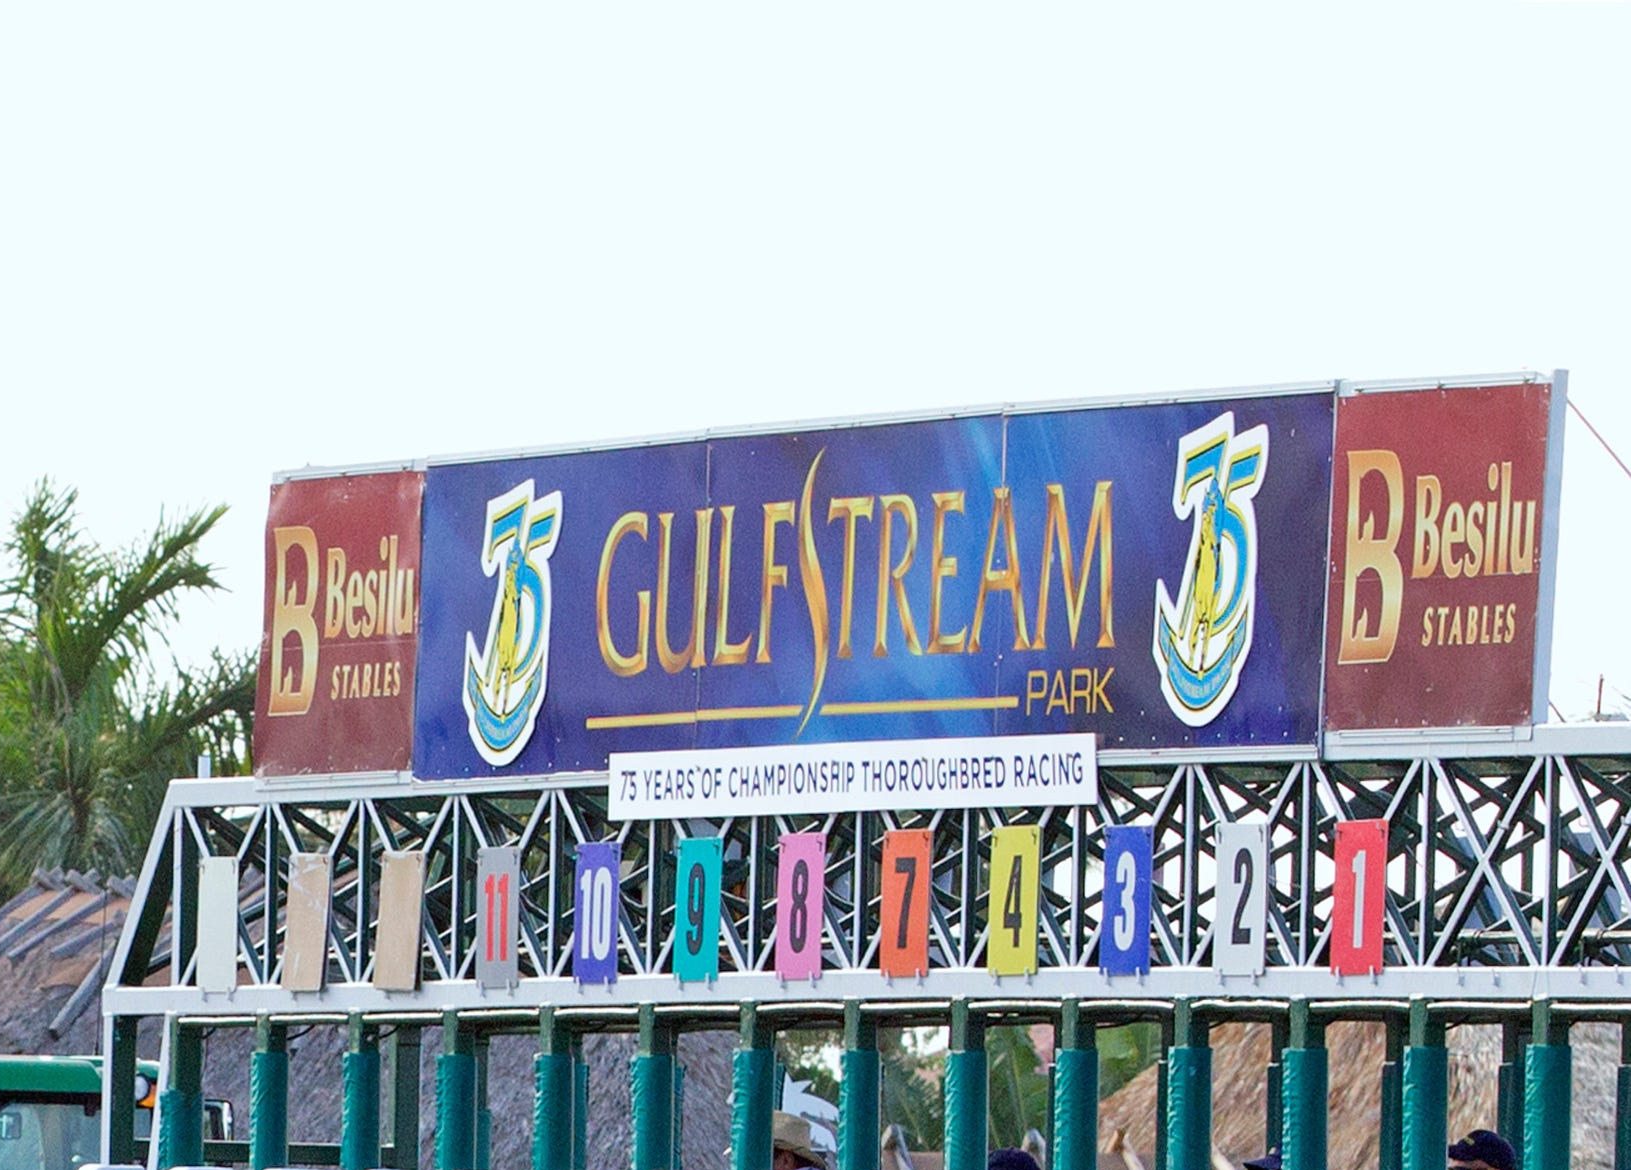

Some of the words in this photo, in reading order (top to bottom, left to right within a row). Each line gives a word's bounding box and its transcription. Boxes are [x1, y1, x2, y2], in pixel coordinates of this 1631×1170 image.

[1338, 450, 1405, 666] B
[1411, 461, 1536, 580] Besilu
[268, 525, 319, 717] B
[323, 535, 415, 640] Besilu
[596, 447, 1115, 742] GULFSTREAM
[1422, 603, 1516, 648] STABLES
[330, 660, 402, 701] STABLES
[1025, 666, 1115, 717] PARK
[619, 770, 638, 802] 75
[643, 769, 696, 801] YEARS
[700, 767, 723, 800] OF
[727, 760, 856, 799] CHAMPIONSHIP
[860, 756, 1006, 793] THOROUGHBRED
[1013, 751, 1084, 788] RACING
[484, 873, 509, 962] 11
[579, 866, 613, 961] 10
[686, 862, 705, 956] 9
[789, 857, 810, 954] 8
[892, 856, 918, 950] 7
[1003, 854, 1024, 948] 4
[1114, 851, 1137, 951] 3
[1230, 847, 1254, 946] 2
[1349, 849, 1367, 948] 1
